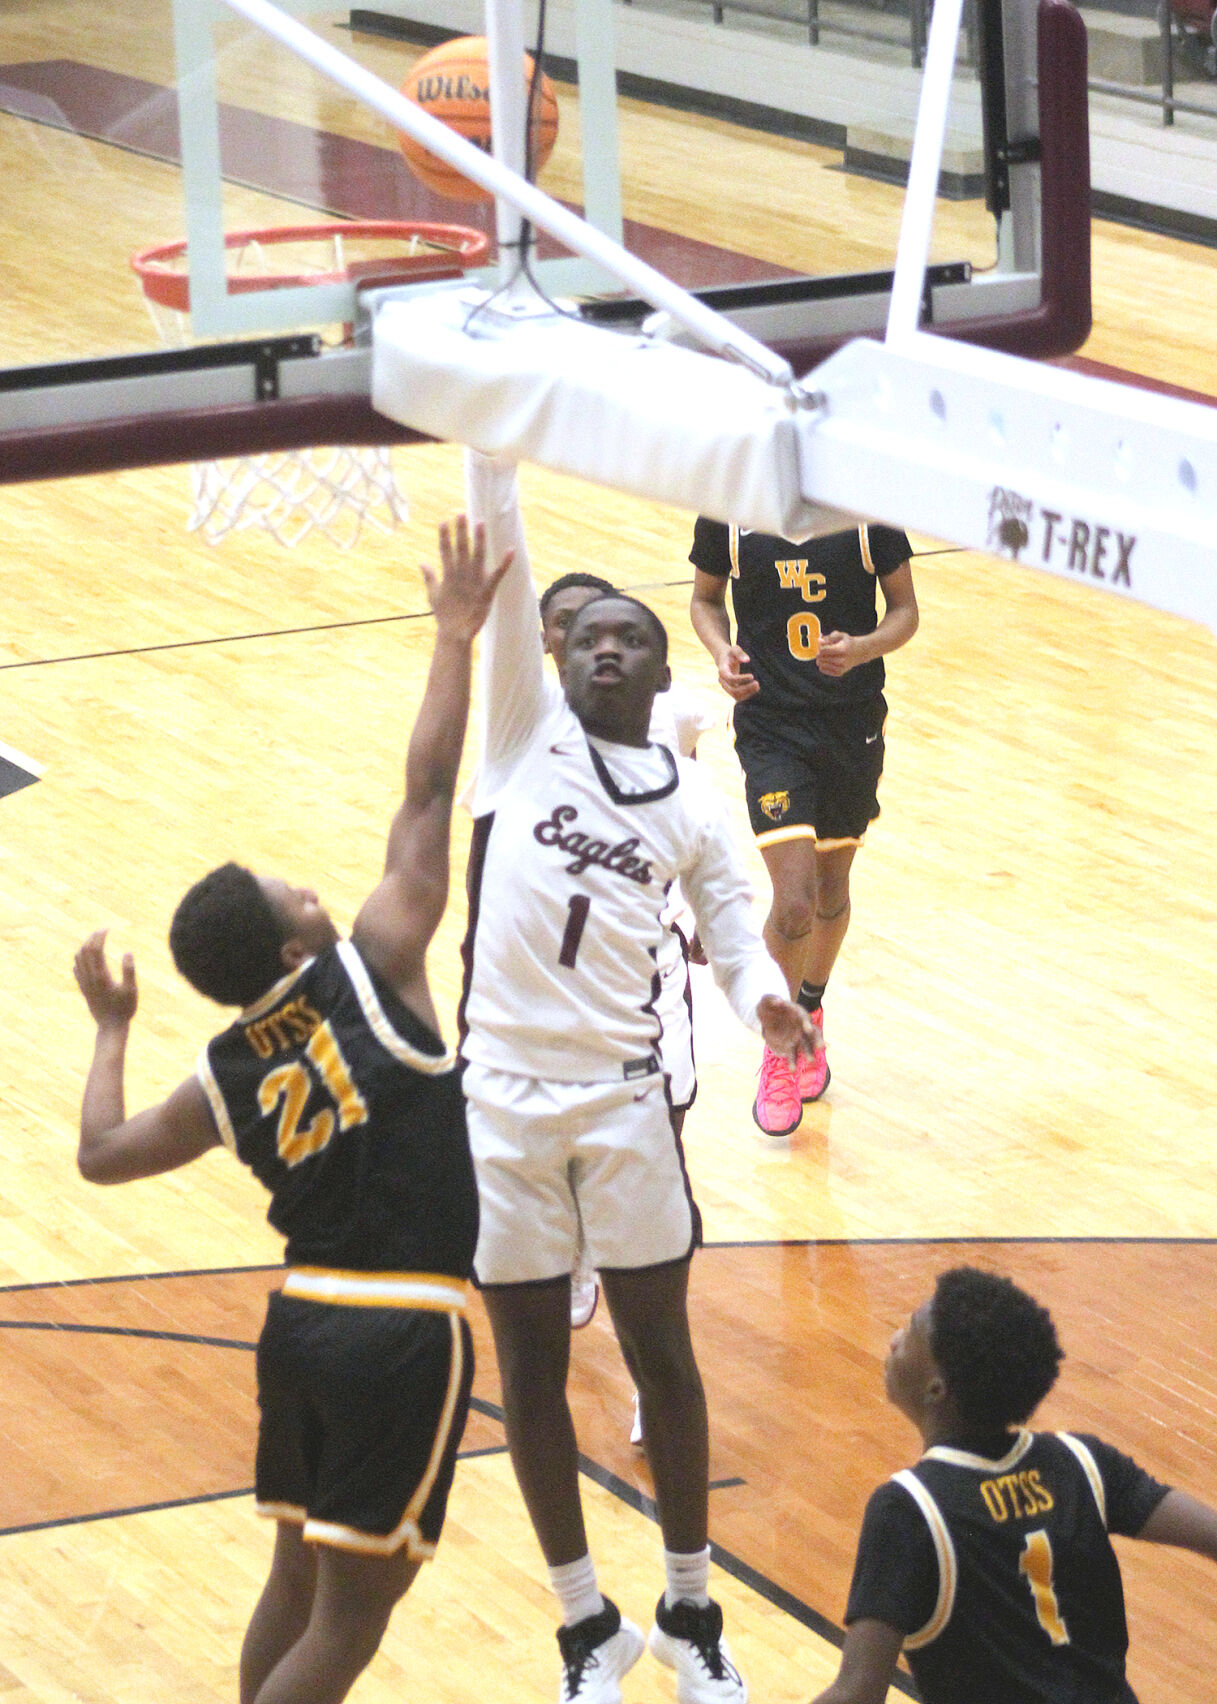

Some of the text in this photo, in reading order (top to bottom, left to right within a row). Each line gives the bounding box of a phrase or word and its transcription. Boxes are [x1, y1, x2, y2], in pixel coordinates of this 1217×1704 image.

[417, 75, 490, 102] Wils
[774, 559, 827, 602] WC
[1041, 507, 1136, 588] T-REX
[786, 611, 821, 661] 0
[533, 805, 653, 884] Eagles
[558, 894, 591, 970] 1
[257, 1019, 369, 1169] 21
[980, 1469, 1054, 1523] OTSS
[1019, 1528, 1071, 1646] 1
